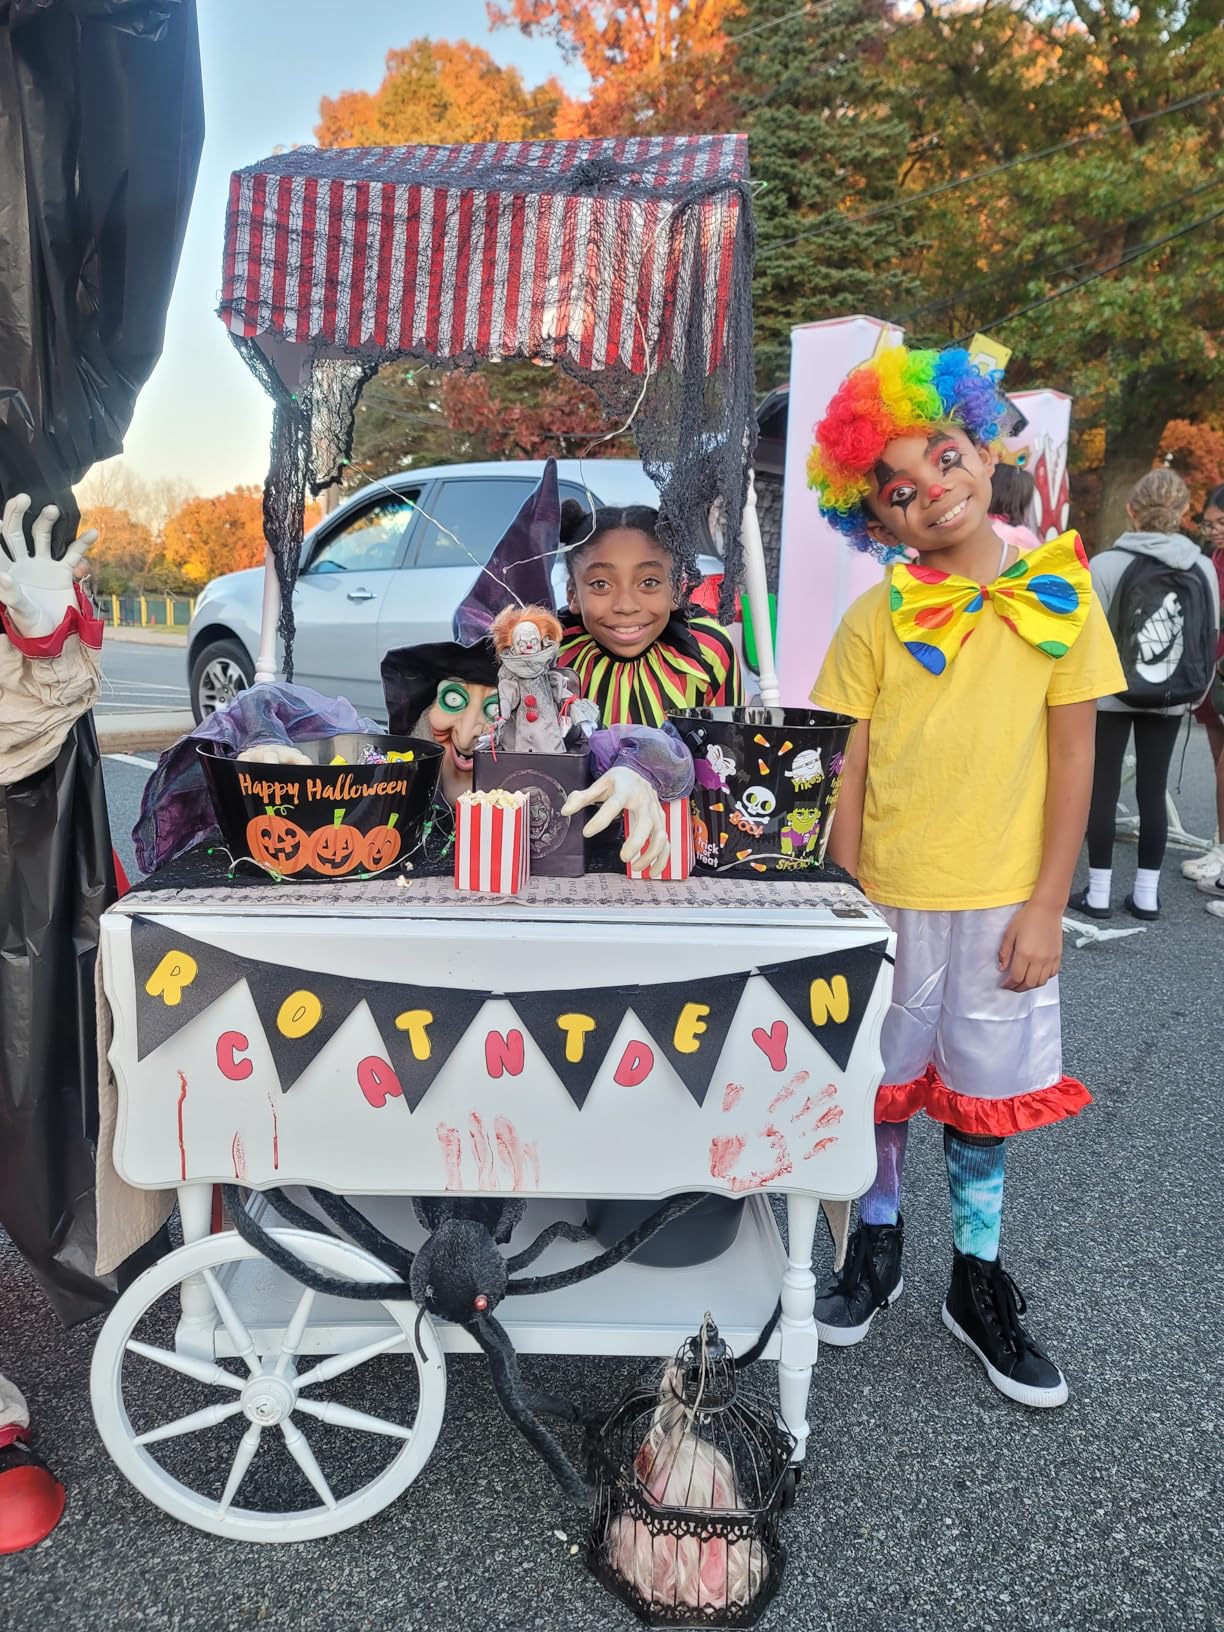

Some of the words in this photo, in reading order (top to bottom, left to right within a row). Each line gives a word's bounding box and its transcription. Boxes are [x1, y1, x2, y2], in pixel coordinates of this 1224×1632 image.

[238, 773, 300, 804] Happy
[306, 773, 408, 802] Halloween
[697, 837, 720, 855] trick
[703, 850, 711, 858] or
[696, 851, 719, 868] treat
